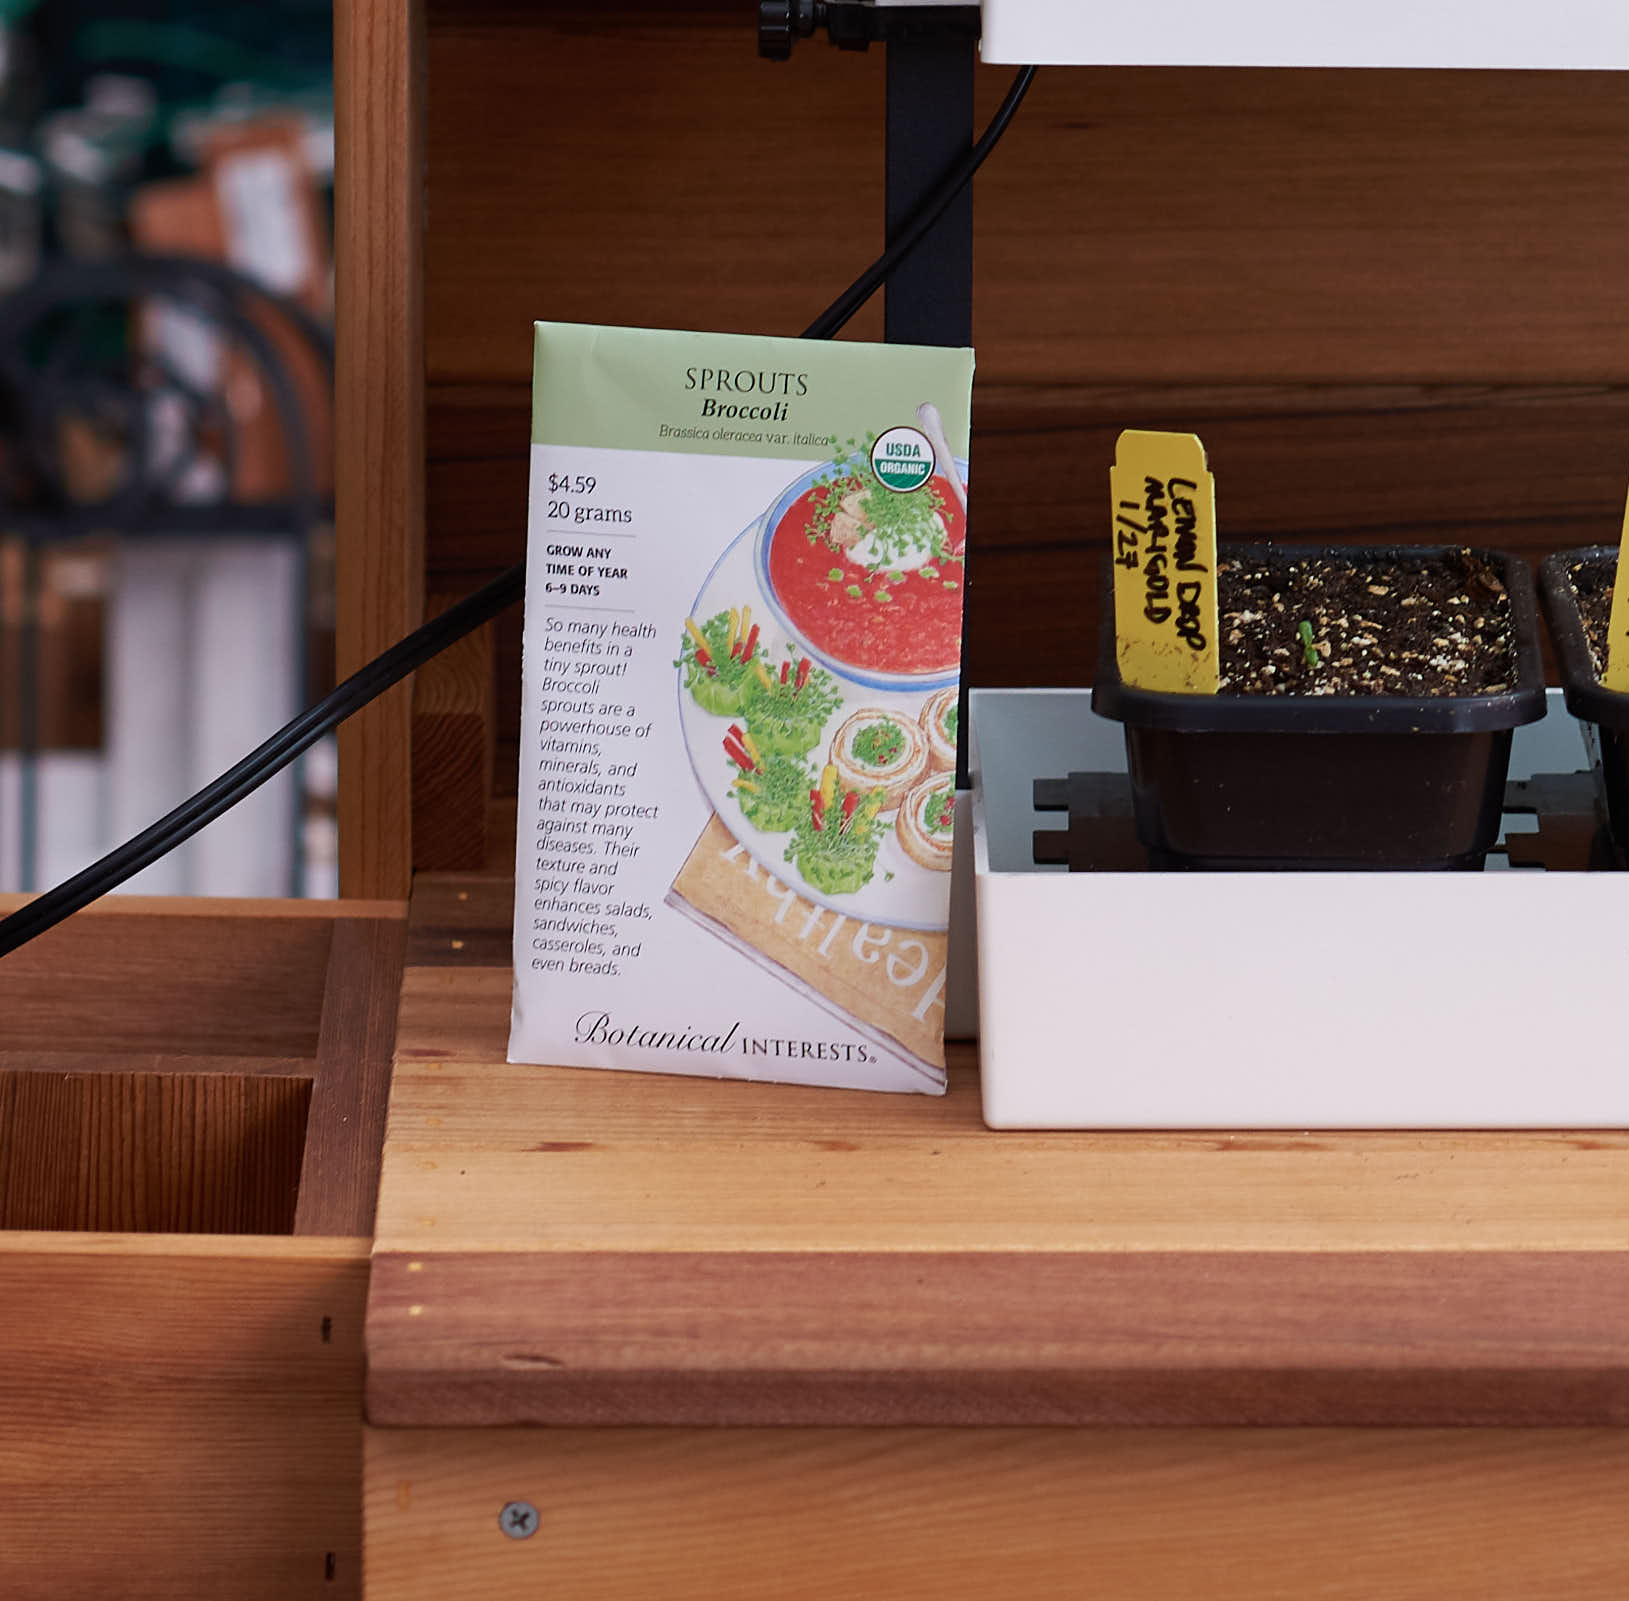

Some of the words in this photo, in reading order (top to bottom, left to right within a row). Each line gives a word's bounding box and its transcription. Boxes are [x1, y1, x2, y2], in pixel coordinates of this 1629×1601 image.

[684, 367, 809, 397] SPROUTS
[701, 398, 789, 422] Broccoli
[659, 424, 709, 441] Brassica
[712, 427, 762, 443] oleracea
[765, 432, 790, 445] var.
[886, 442, 921, 458] USDA
[879, 461, 926, 476] ORGANIC
[548, 473, 597, 495] $4.59
[547, 501, 570, 520] 20
[574, 504, 632, 524] grams
[1115, 501, 1149, 569] 1/27
[546, 544, 582, 558] GROW
[586, 546, 612, 560] ANY
[546, 563, 574, 577] TIME
[579, 565, 594, 578] OF
[597, 565, 628, 579] YEAR
[570, 584, 600, 597] DAYS
[544, 617, 563, 632] So
[567, 622, 607, 639] many
[611, 621, 657, 639] health
[544, 637, 601, 655] benefits
[606, 641, 620, 655] in
[624, 646, 633, 657] a
[543, 658, 571, 676] tiny
[573, 662, 628, 680] sprout!
[542, 677, 600, 695] Broccoli
[541, 699, 595, 717] sprouts
[598, 703, 623, 716] are
[626, 706, 636, 717] a
[539, 719, 631, 737] powerhouse
[635, 721, 653, 738] of
[540, 738, 602, 757] vitamins,
[538, 758, 601, 777] minerals,
[607, 762, 637, 778] and
[538, 777, 626, 797] antioxidants
[539, 797, 566, 813] that
[570, 801, 601, 818] may
[604, 802, 660, 820] protect
[537, 818, 588, 834] against
[592, 822, 633, 840] many
[536, 836, 597, 854] diseases.
[604, 840, 641, 857] Their
[536, 857, 585, 874] texture
[589, 861, 619, 876] and
[535, 877, 569, 895] spicy
[574, 878, 615, 896] flavor
[534, 897, 600, 915] enhances
[605, 902, 653, 920] salads,
[533, 917, 618, 937] sandwiches,
[532, 937, 606, 957] casseroles,
[612, 942, 642, 957] and
[531, 956, 564, 972] even
[569, 957, 622, 976] breads.
[575, 1010, 739, 1053] Botanical
[742, 1039, 868, 1062] INTERESTS
